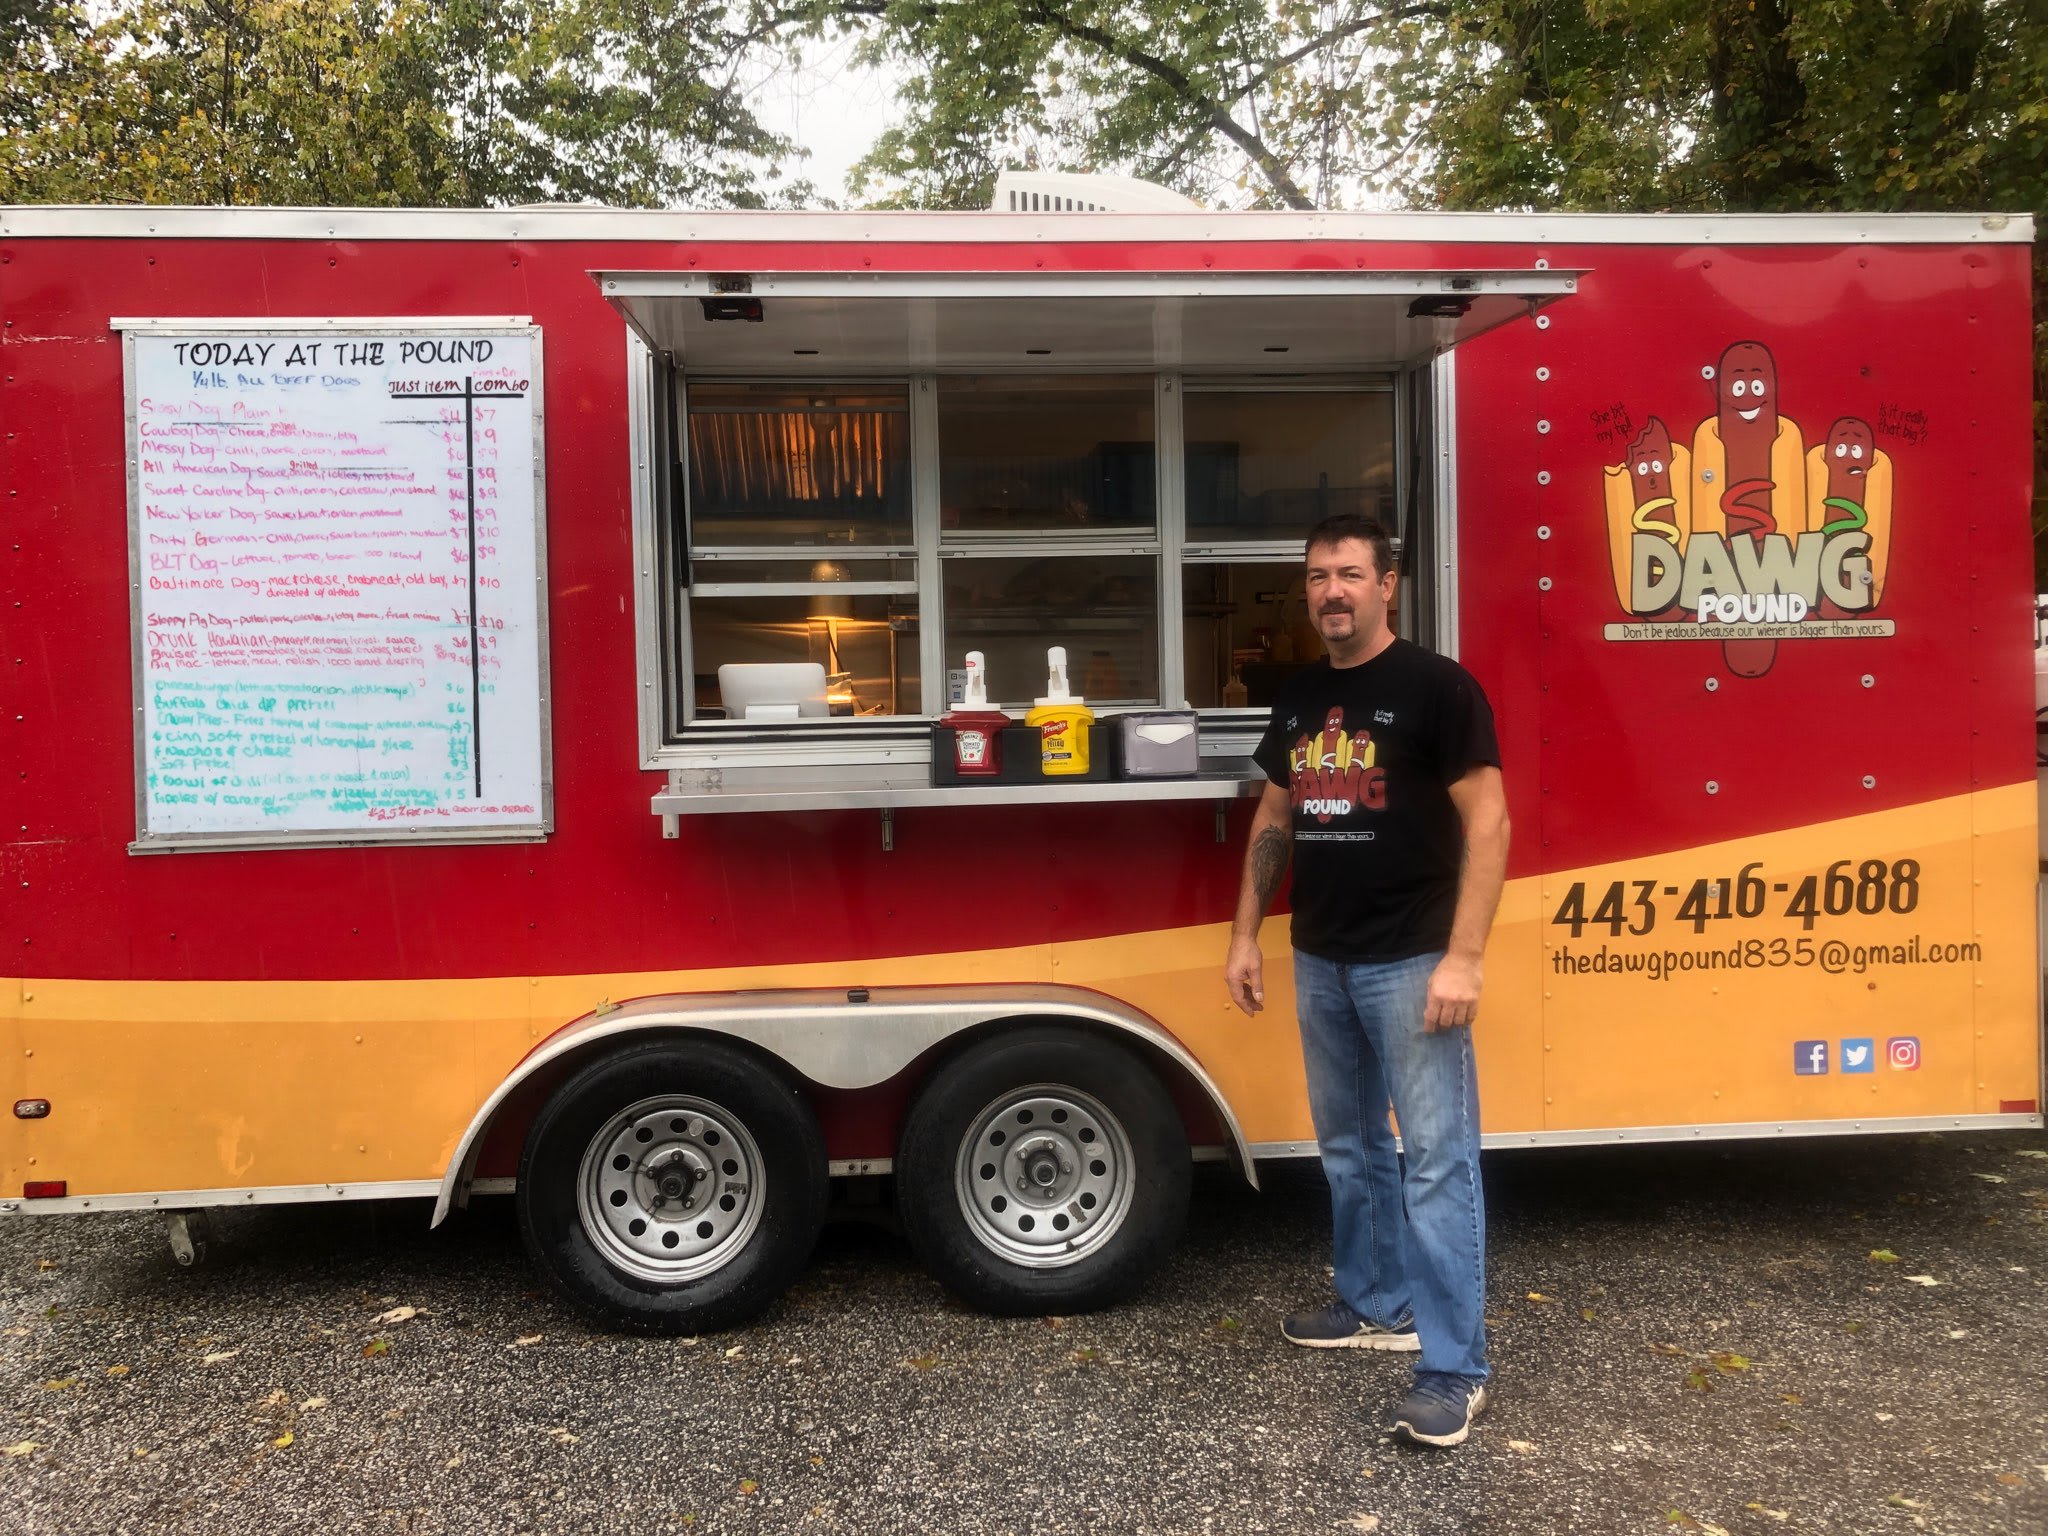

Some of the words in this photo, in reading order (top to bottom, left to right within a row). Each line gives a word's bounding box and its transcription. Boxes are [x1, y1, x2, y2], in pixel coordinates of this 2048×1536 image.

[174, 342, 275, 366] TODAY
[285, 342, 321, 367] AT
[334, 342, 385, 366] THE
[400, 340, 493, 363] POUND
[474, 379, 529, 391] combo
[1596, 429, 1614, 446] my
[149, 552, 187, 571] BLT
[1631, 531, 1875, 614] DAWG
[149, 575, 225, 590] Baltimore
[1696, 593, 1810, 625] POUND
[1622, 623, 1650, 639] Don't
[1651, 623, 1664, 638] be
[1664, 623, 1698, 640] jealous
[1699, 623, 1735, 638] because
[1737, 625, 1755, 638] our
[1756, 623, 1789, 637] wiener
[1790, 623, 1798, 637] is
[1799, 622, 1829, 639] bigger
[1830, 623, 1855, 637] than
[1043, 721, 1067, 735] French's
[1289, 767, 1387, 810] DAWG
[1303, 799, 1351, 815] POUND
[1551, 858, 1921, 938] 443-416-4688
[1551, 936, 1984, 982] thedawgpound835@gmail.com
